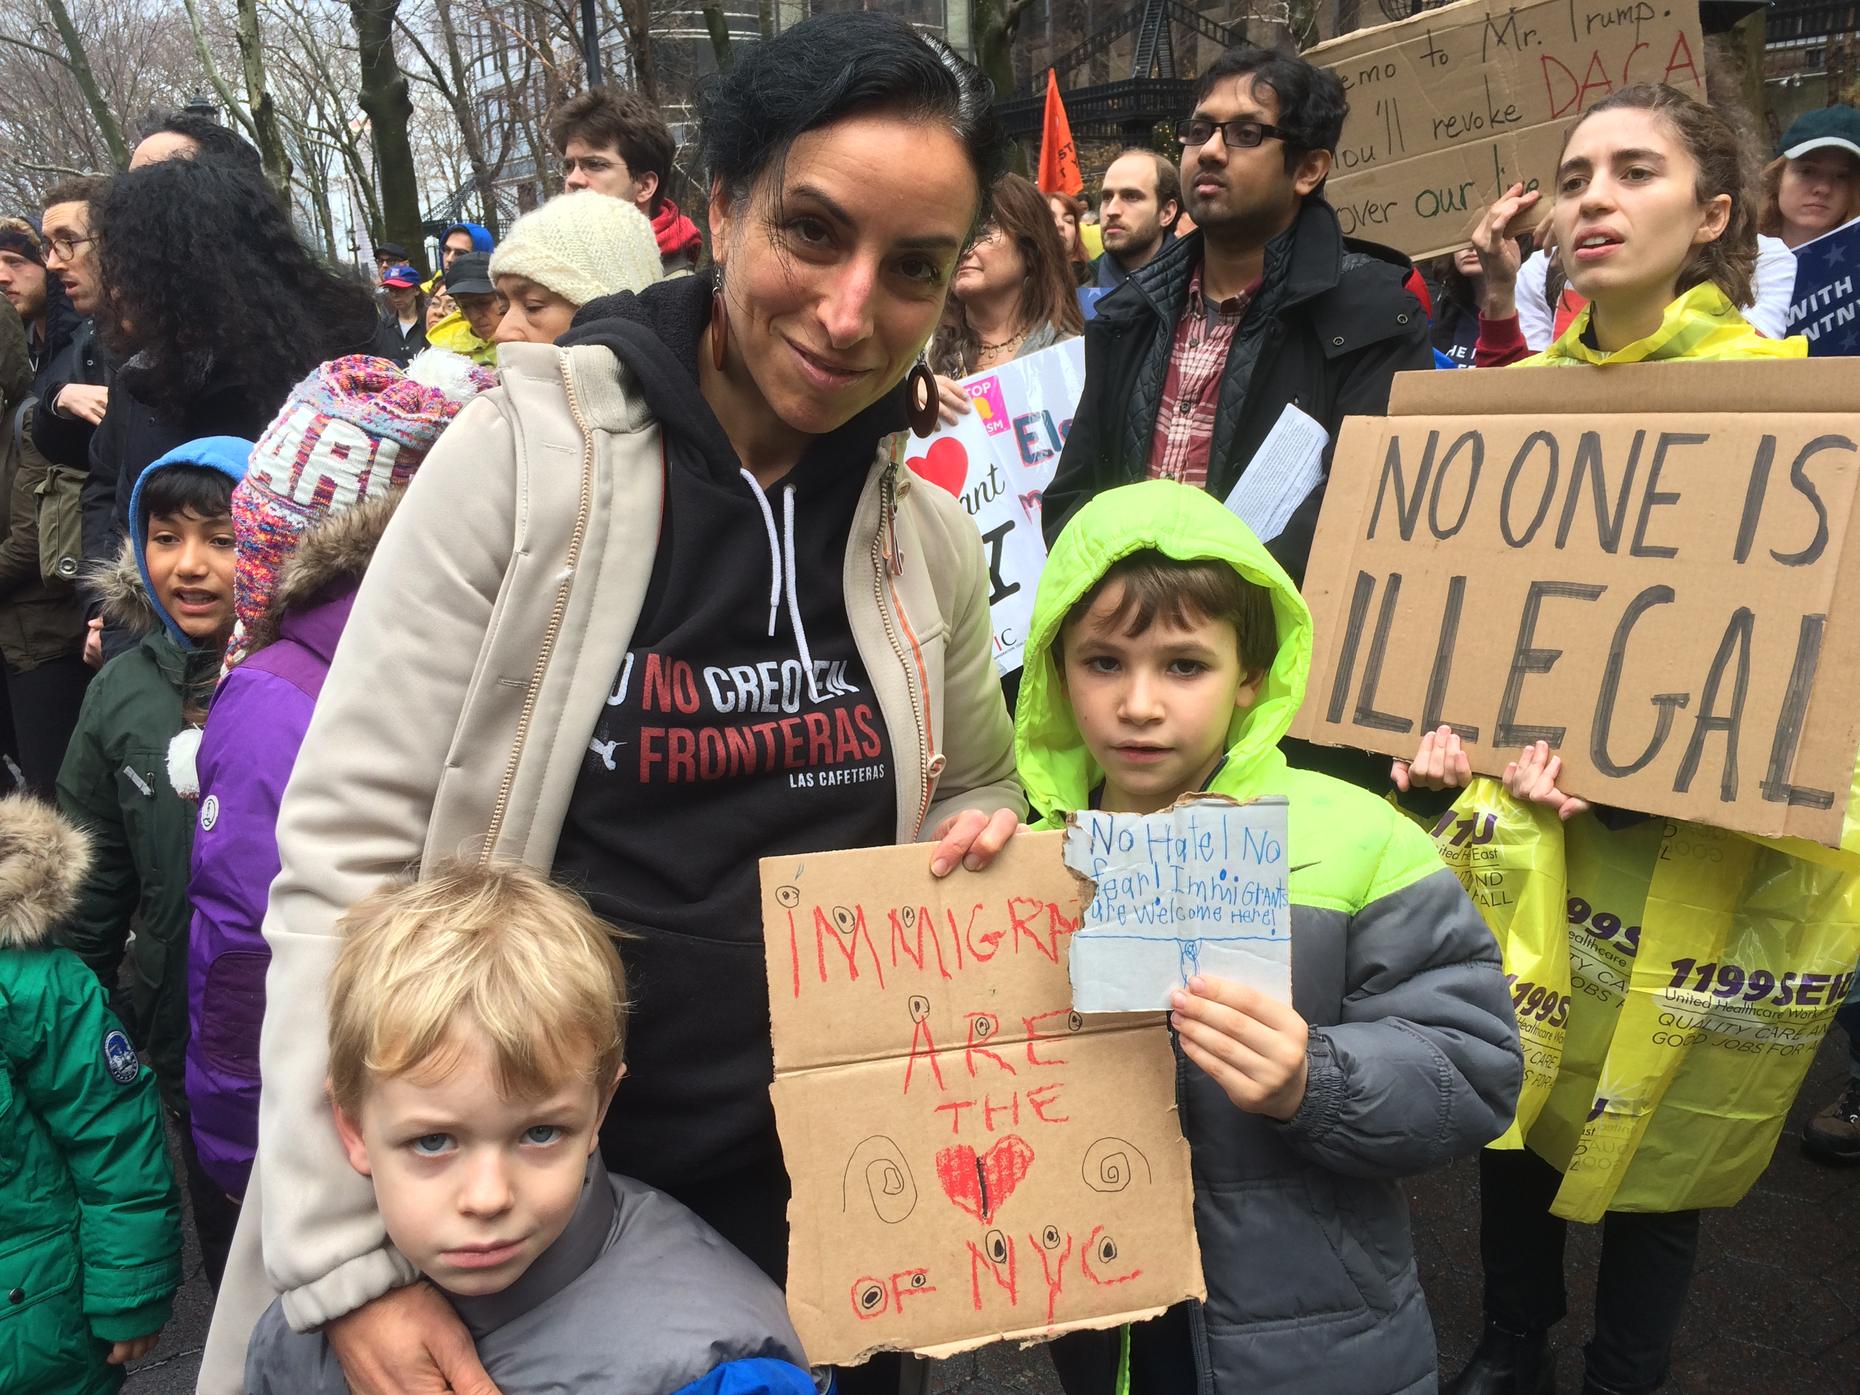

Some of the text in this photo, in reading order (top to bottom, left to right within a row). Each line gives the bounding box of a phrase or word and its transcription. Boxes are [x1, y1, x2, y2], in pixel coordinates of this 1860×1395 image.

[1340, 63, 1397, 91] emo
[1420, 28, 1449, 67] to
[1483, 7, 1543, 63] Mr.
[1432, 75, 1523, 140] revoke
[1336, 199, 1398, 235] over
[1415, 181, 1476, 218] our
[1786, 275, 1853, 327] WITH
[966, 382, 992, 398] TOP
[960, 463, 1006, 517] ant
[1367, 429, 1485, 541] NO
[1500, 429, 1710, 559] ONE
[1732, 434, 1858, 566] IS
[642, 653, 700, 714] NO
[703, 659, 803, 714] CREO
[1326, 570, 1835, 810] ILLEGAL
[639, 703, 881, 784] FRONTERAS
[789, 764, 885, 789] LAS CAFETERAS
[1090, 814, 1135, 855] No
[1242, 826, 1282, 865] No
[1091, 898, 1127, 927] are
[786, 896, 1080, 998] IMMIGRA
[1568, 930, 1628, 968] ealthcare
[1571, 976, 1613, 1003] OBS
[1665, 988, 1712, 1010] United
[1715, 999, 1784, 1021] Healthcare
[903, 1008, 1074, 1094] ARE
[1652, 1031, 1708, 1048] GOOD
[1711, 1038, 1767, 1055] JOBS
[1766, 1042, 1805, 1057] FOR
[1658, 1012, 1750, 1036] QUALITY
[1755, 1024, 1807, 1041] CARE
[934, 1083, 1069, 1134] THE
[851, 1225, 1143, 1333] OF NYC
